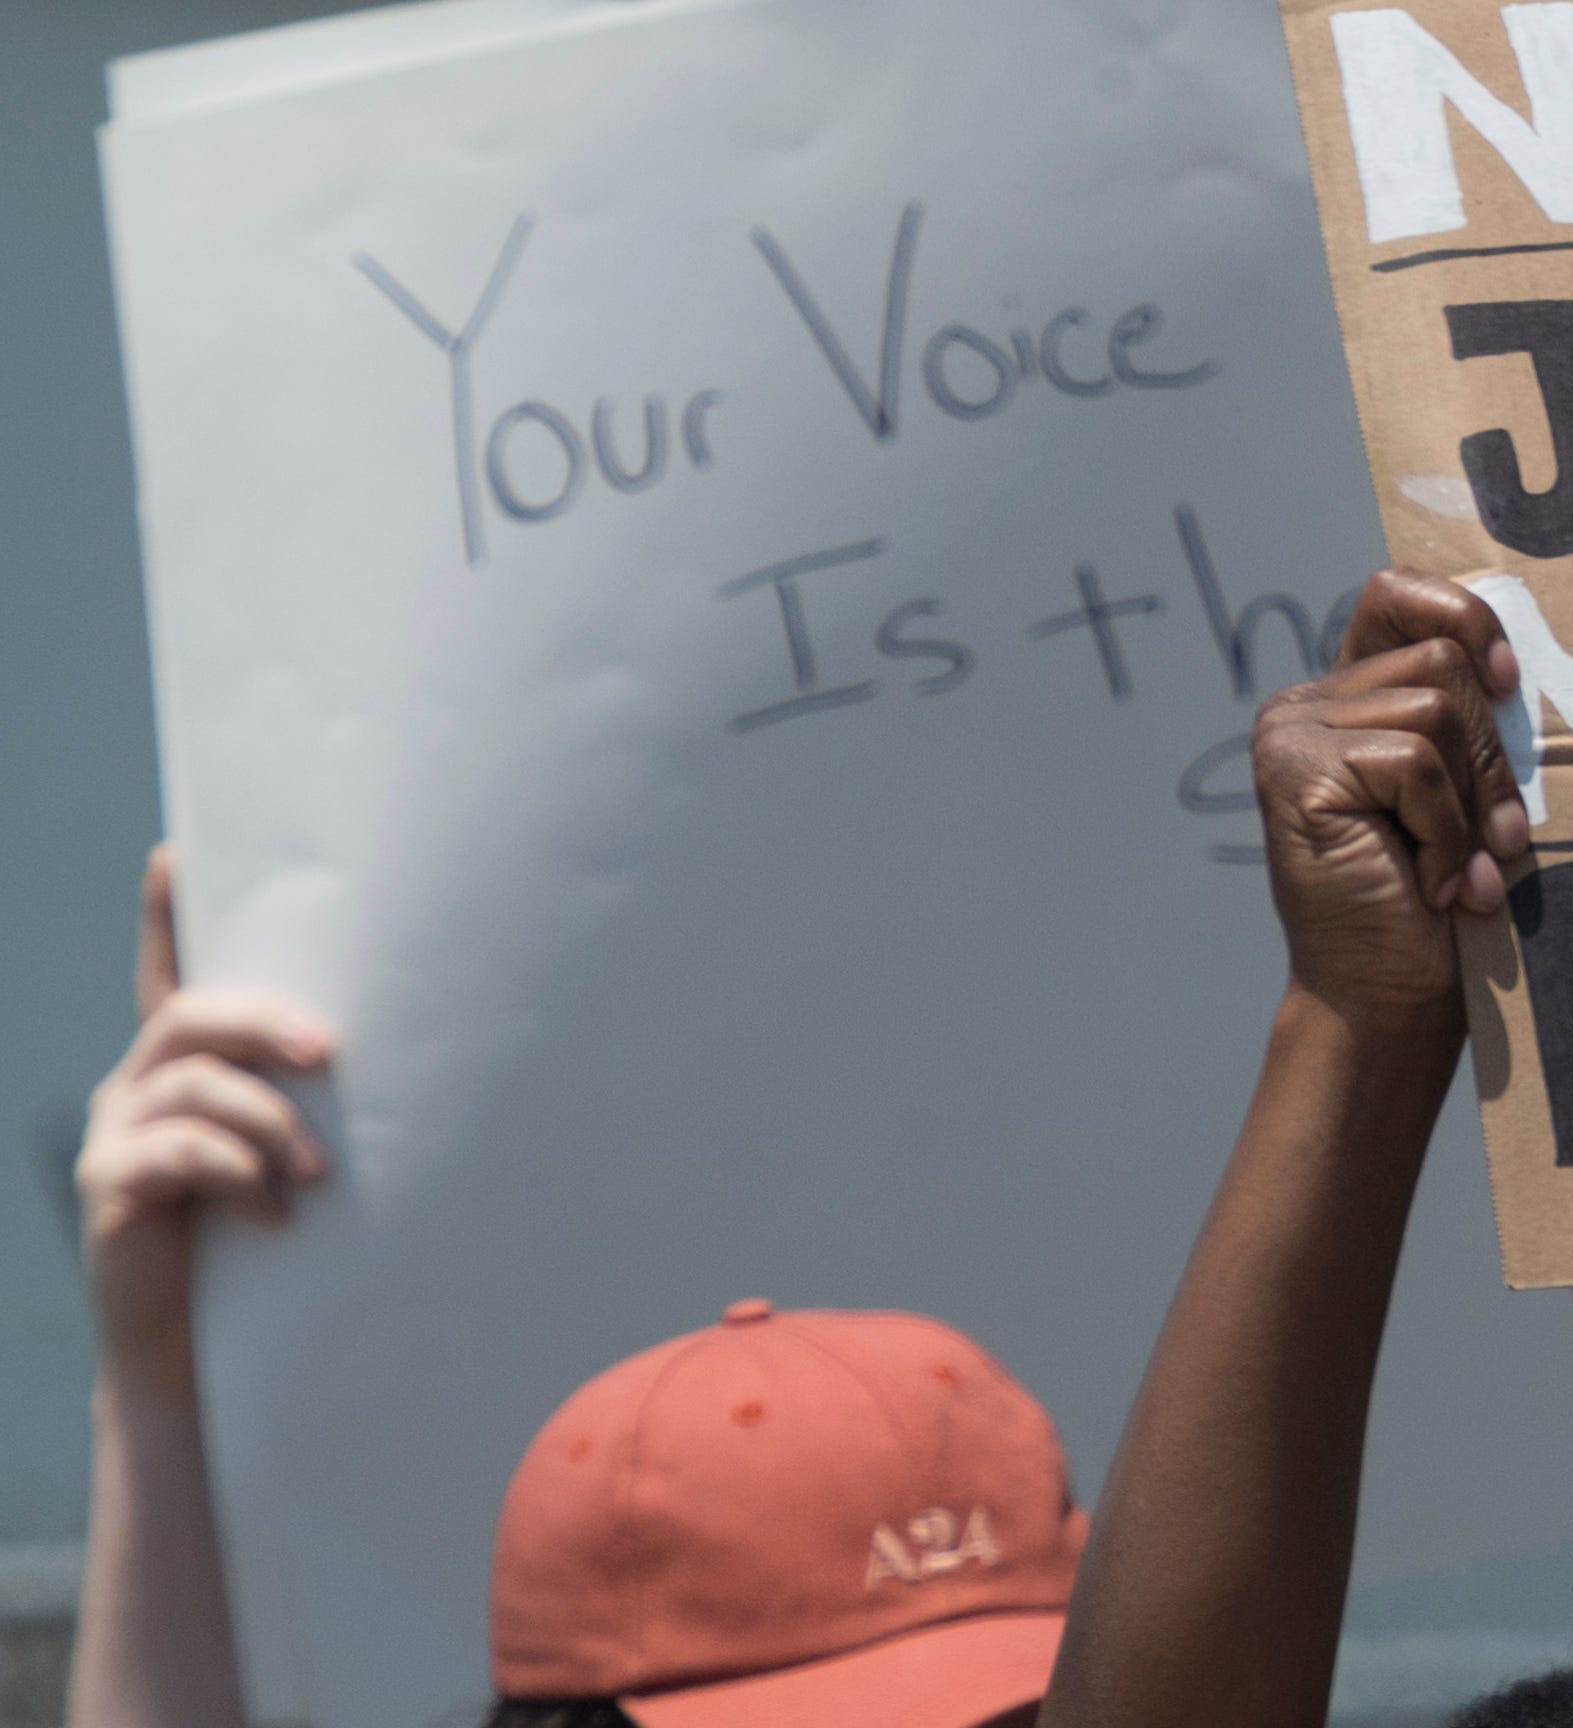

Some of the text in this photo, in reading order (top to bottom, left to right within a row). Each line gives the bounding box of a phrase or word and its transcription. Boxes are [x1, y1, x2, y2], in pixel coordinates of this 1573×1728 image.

[352, 203, 1219, 568] Your Voice
[719, 536, 976, 734] Is
